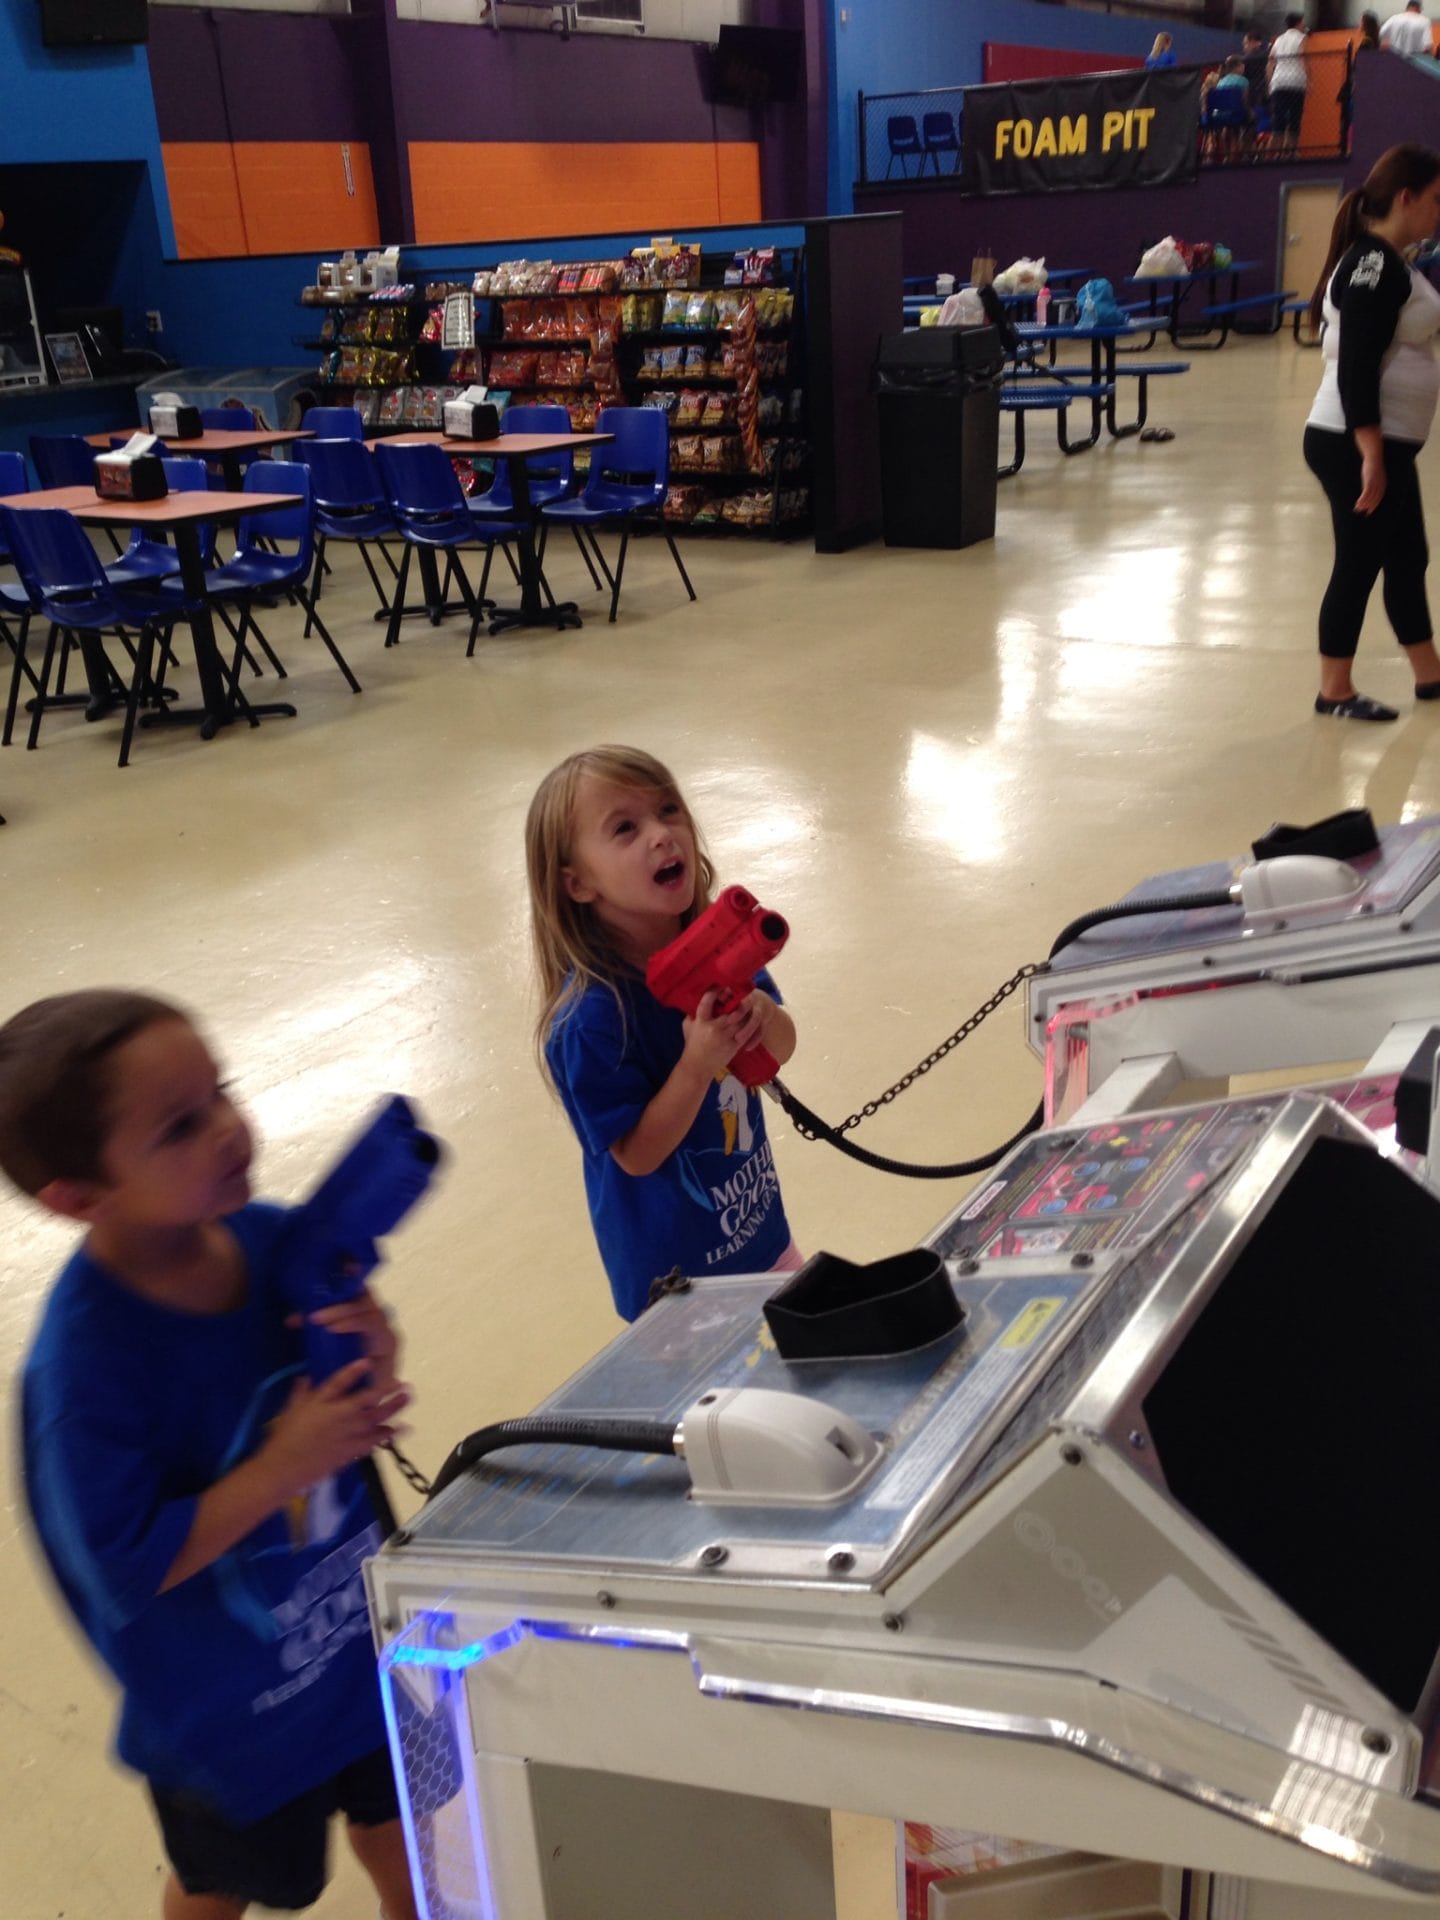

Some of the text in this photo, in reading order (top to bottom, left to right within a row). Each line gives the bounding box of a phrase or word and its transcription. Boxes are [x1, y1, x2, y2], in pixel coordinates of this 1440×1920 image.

[995, 108, 1155, 160] FOAM PIT
[705, 1205, 766, 1265] LEARNING
